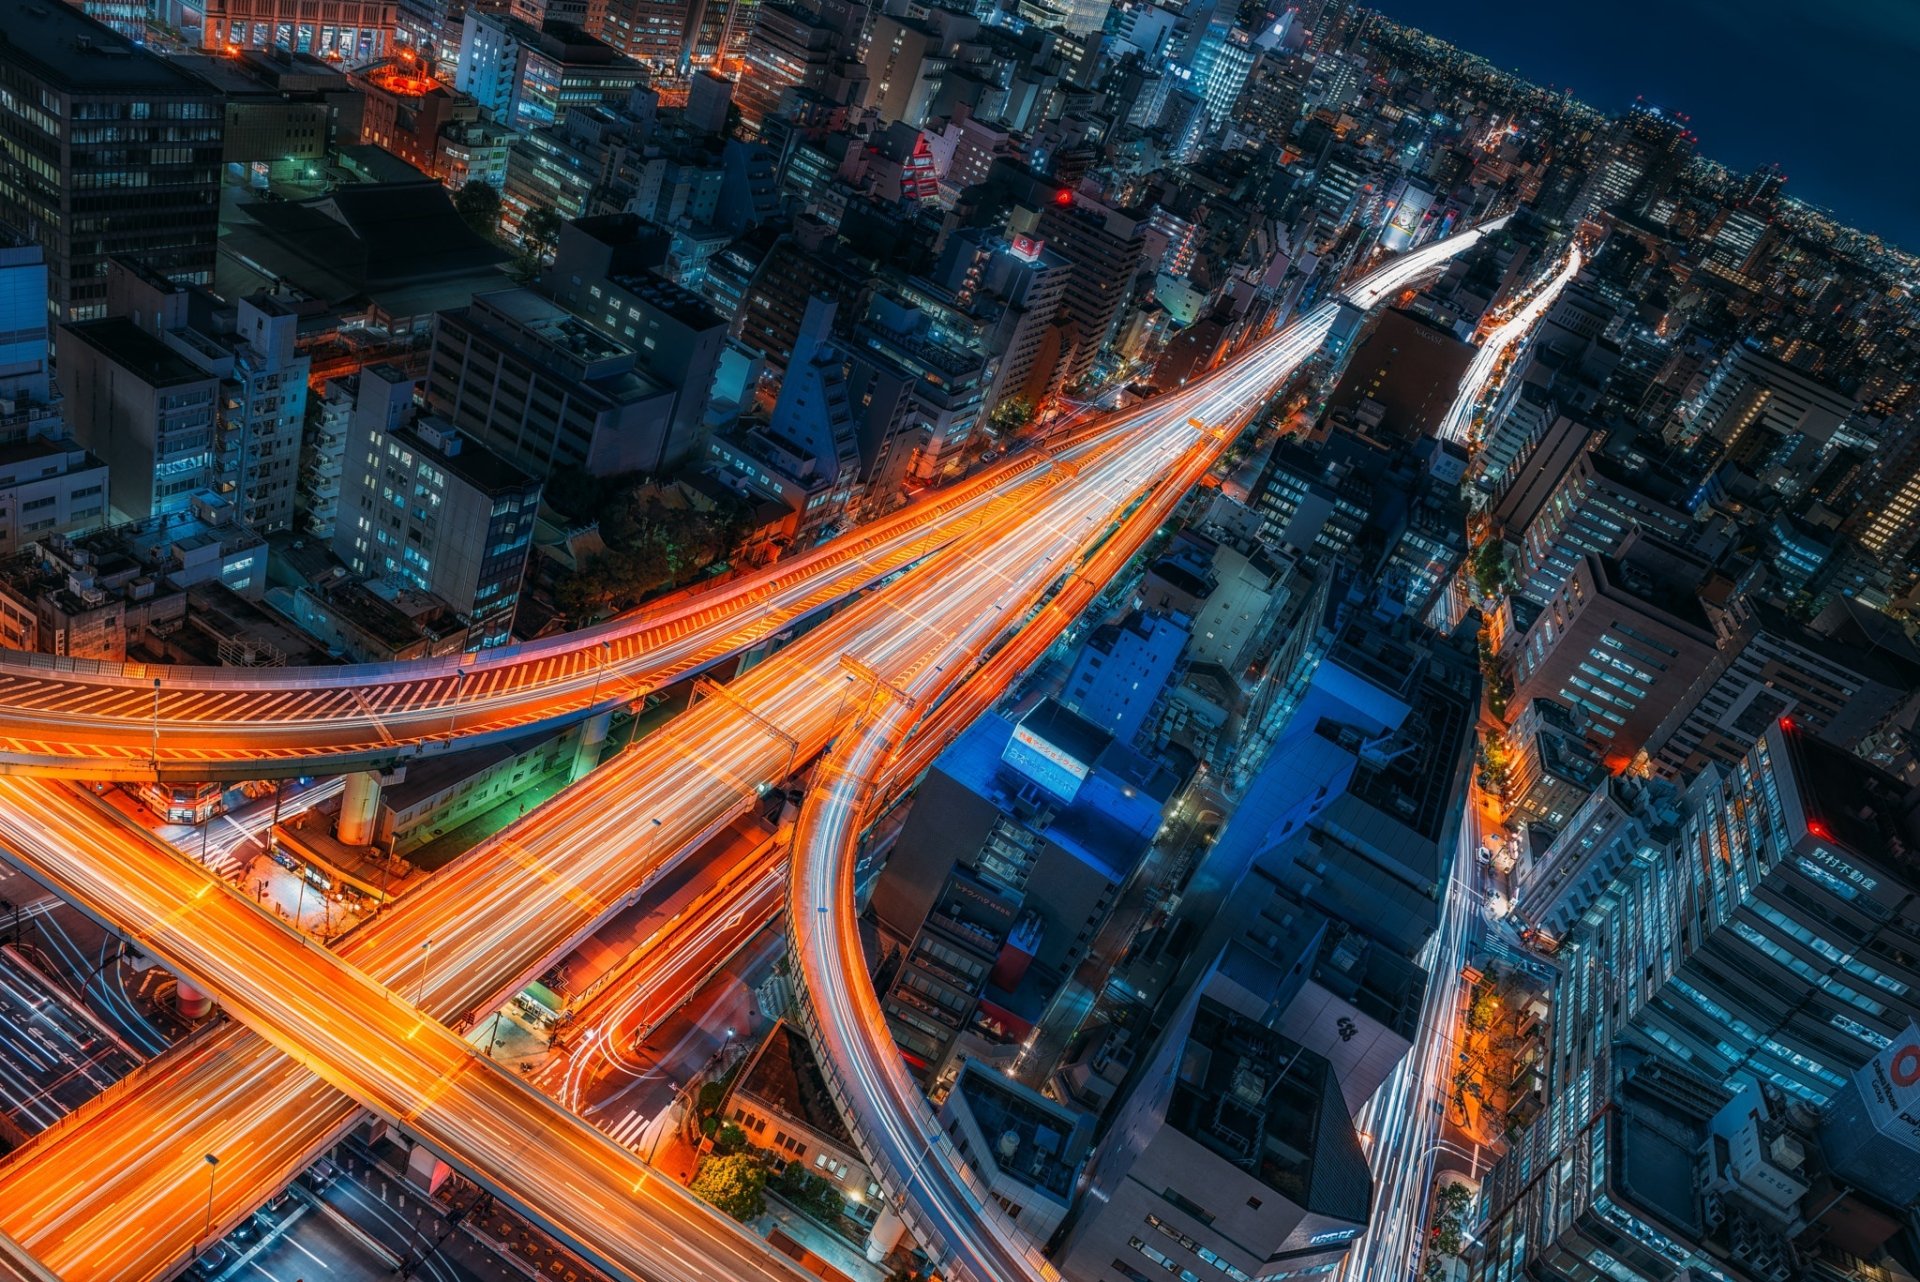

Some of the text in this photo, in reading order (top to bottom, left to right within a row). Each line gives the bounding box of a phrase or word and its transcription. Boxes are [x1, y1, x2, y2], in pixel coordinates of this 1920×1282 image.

[1413, 326, 1443, 345] NAGASE
[1812, 847, 1878, 890] 野村不動産
[1871, 1079, 1885, 1104] Group
[1872, 1058, 1898, 1111] Daiwa House
